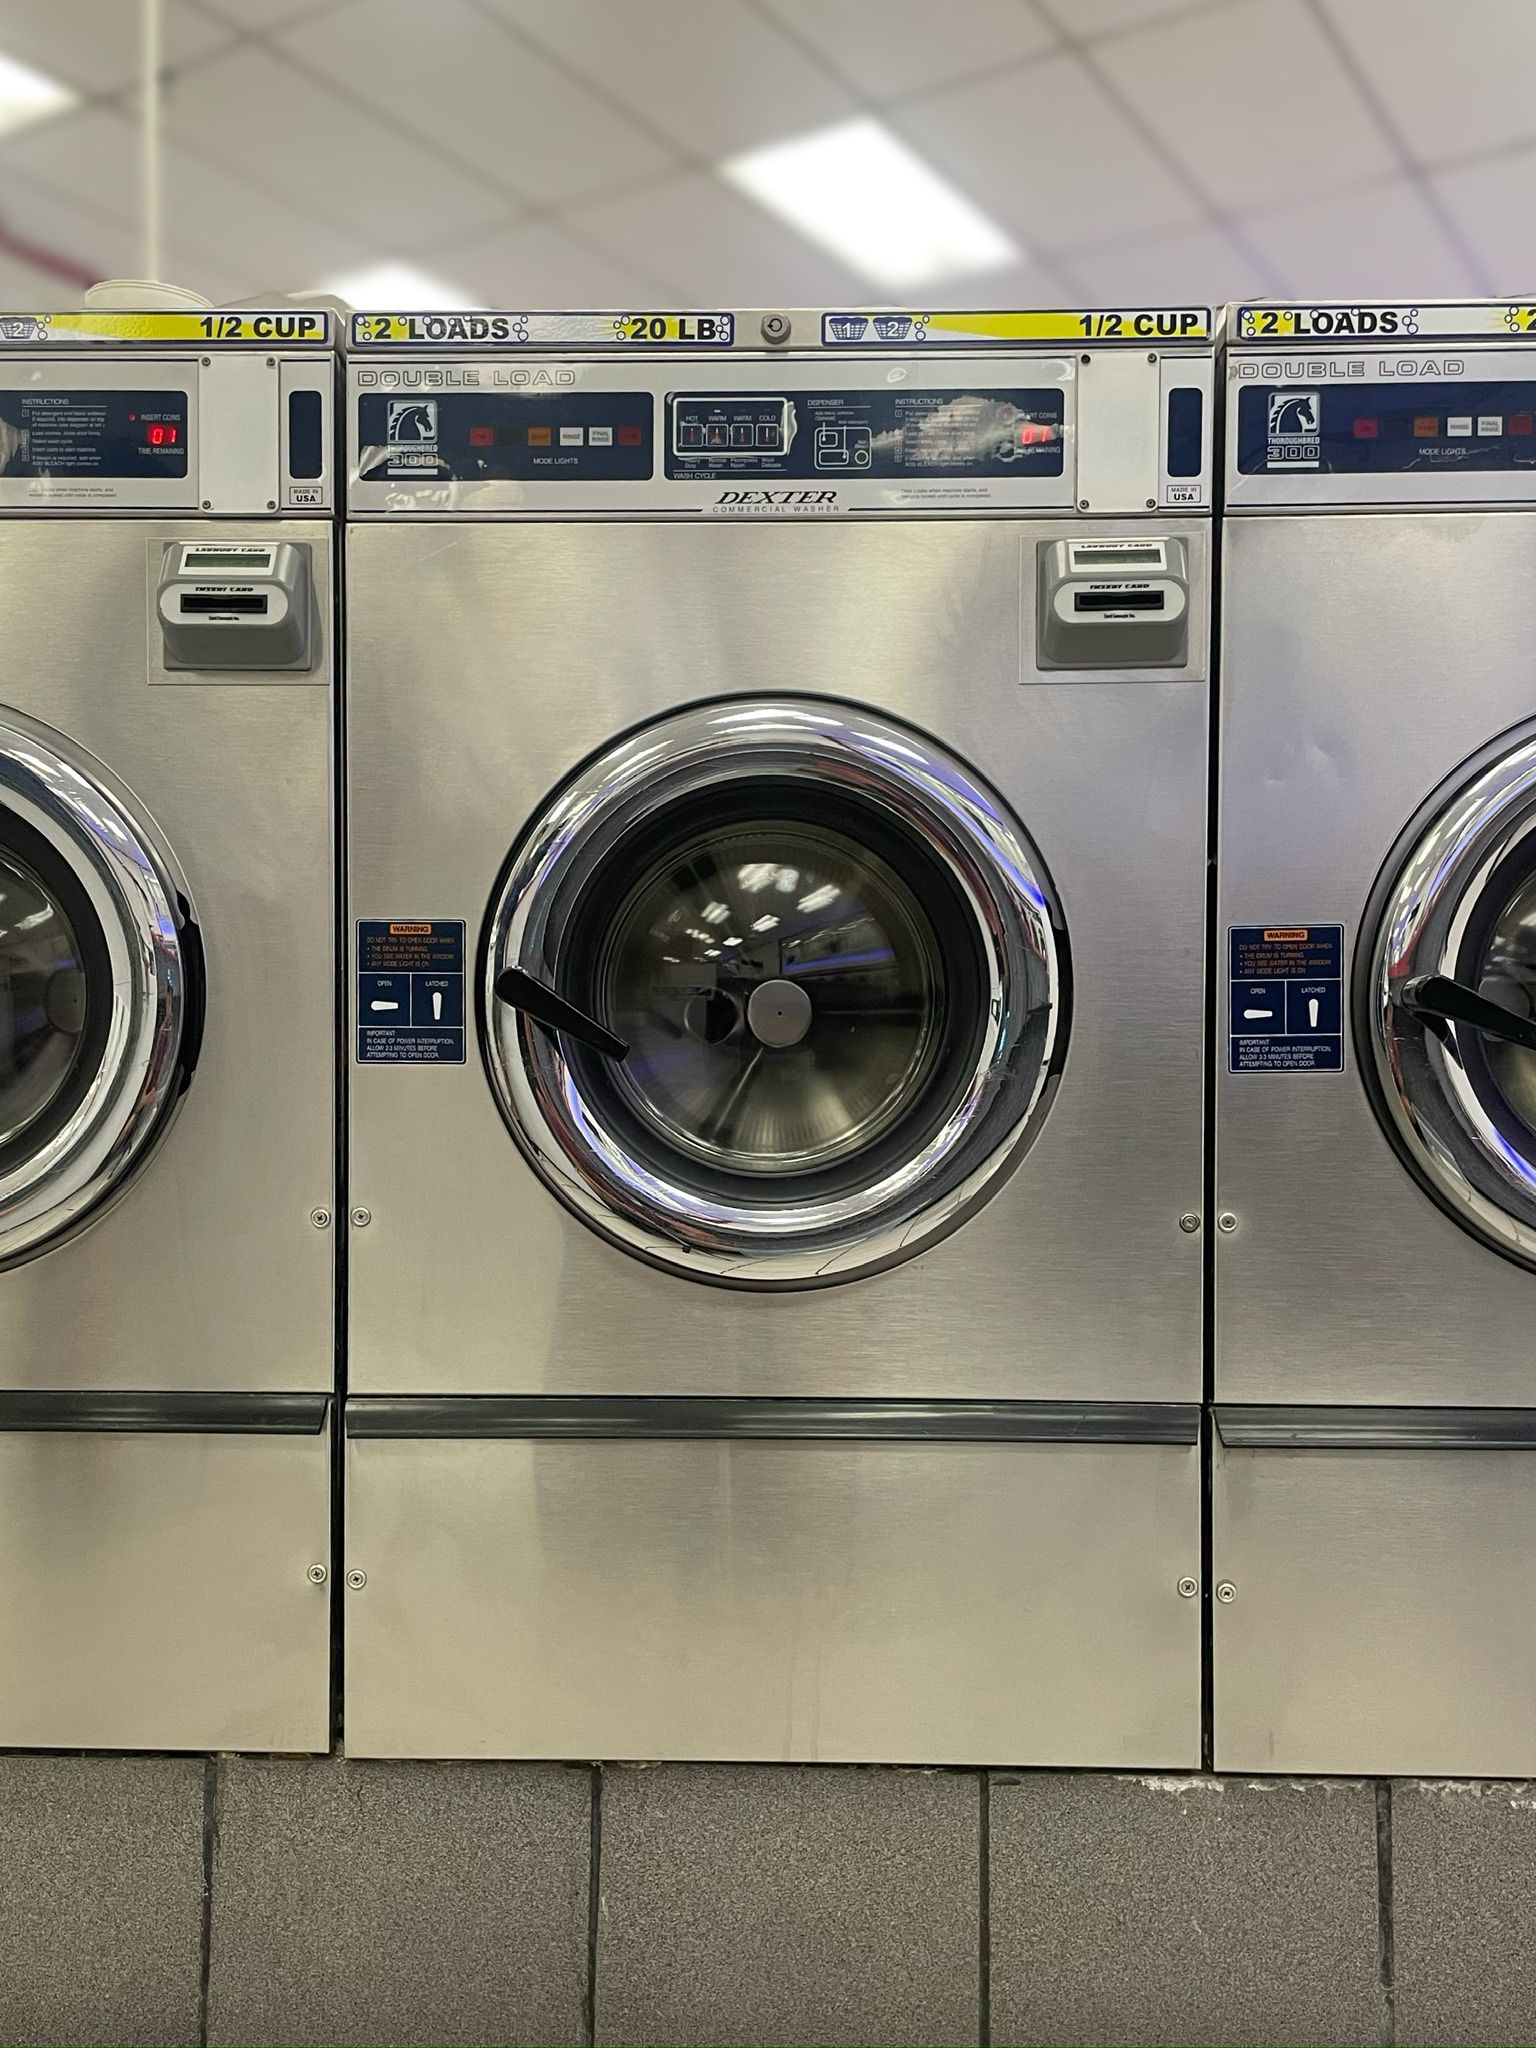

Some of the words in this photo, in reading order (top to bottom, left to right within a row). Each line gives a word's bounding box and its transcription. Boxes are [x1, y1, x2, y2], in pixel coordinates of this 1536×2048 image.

[200, 316, 242, 338] 1/2
[253, 316, 317, 338] CUP
[374, 318, 392, 340] 2
[408, 318, 510, 340] LOADS
[630, 318, 667, 340] 20
[678, 318, 716, 340] LB
[842, 322, 852, 338] 1
[887, 322, 899, 337] 2
[1078, 314, 1123, 336] 1/2
[1134, 314, 1199, 336] CUP
[1260, 312, 1279, 335] 2
[1293, 312, 1398, 336] LOADS
[1238, 360, 1365, 379] DOUBLE
[1378, 360, 1464, 376] LOAD
[358, 370, 480, 386] DOUBLE
[494, 370, 576, 386] LOAD
[152, 428, 177, 445] 01
[1022, 428, 1047, 444] 01
[1267, 436, 1320, 445] THOROUGHBRED
[387, 453, 438, 466] 300
[1267, 445, 1320, 460] 300
[1418, 448, 1440, 456] MODE
[533, 457, 552, 465] MODE
[554, 457, 578, 465] LIGHTS
[296, 494, 316, 502] USA
[714, 490, 838, 504] DEXTER
[1173, 493, 1194, 501] USA
